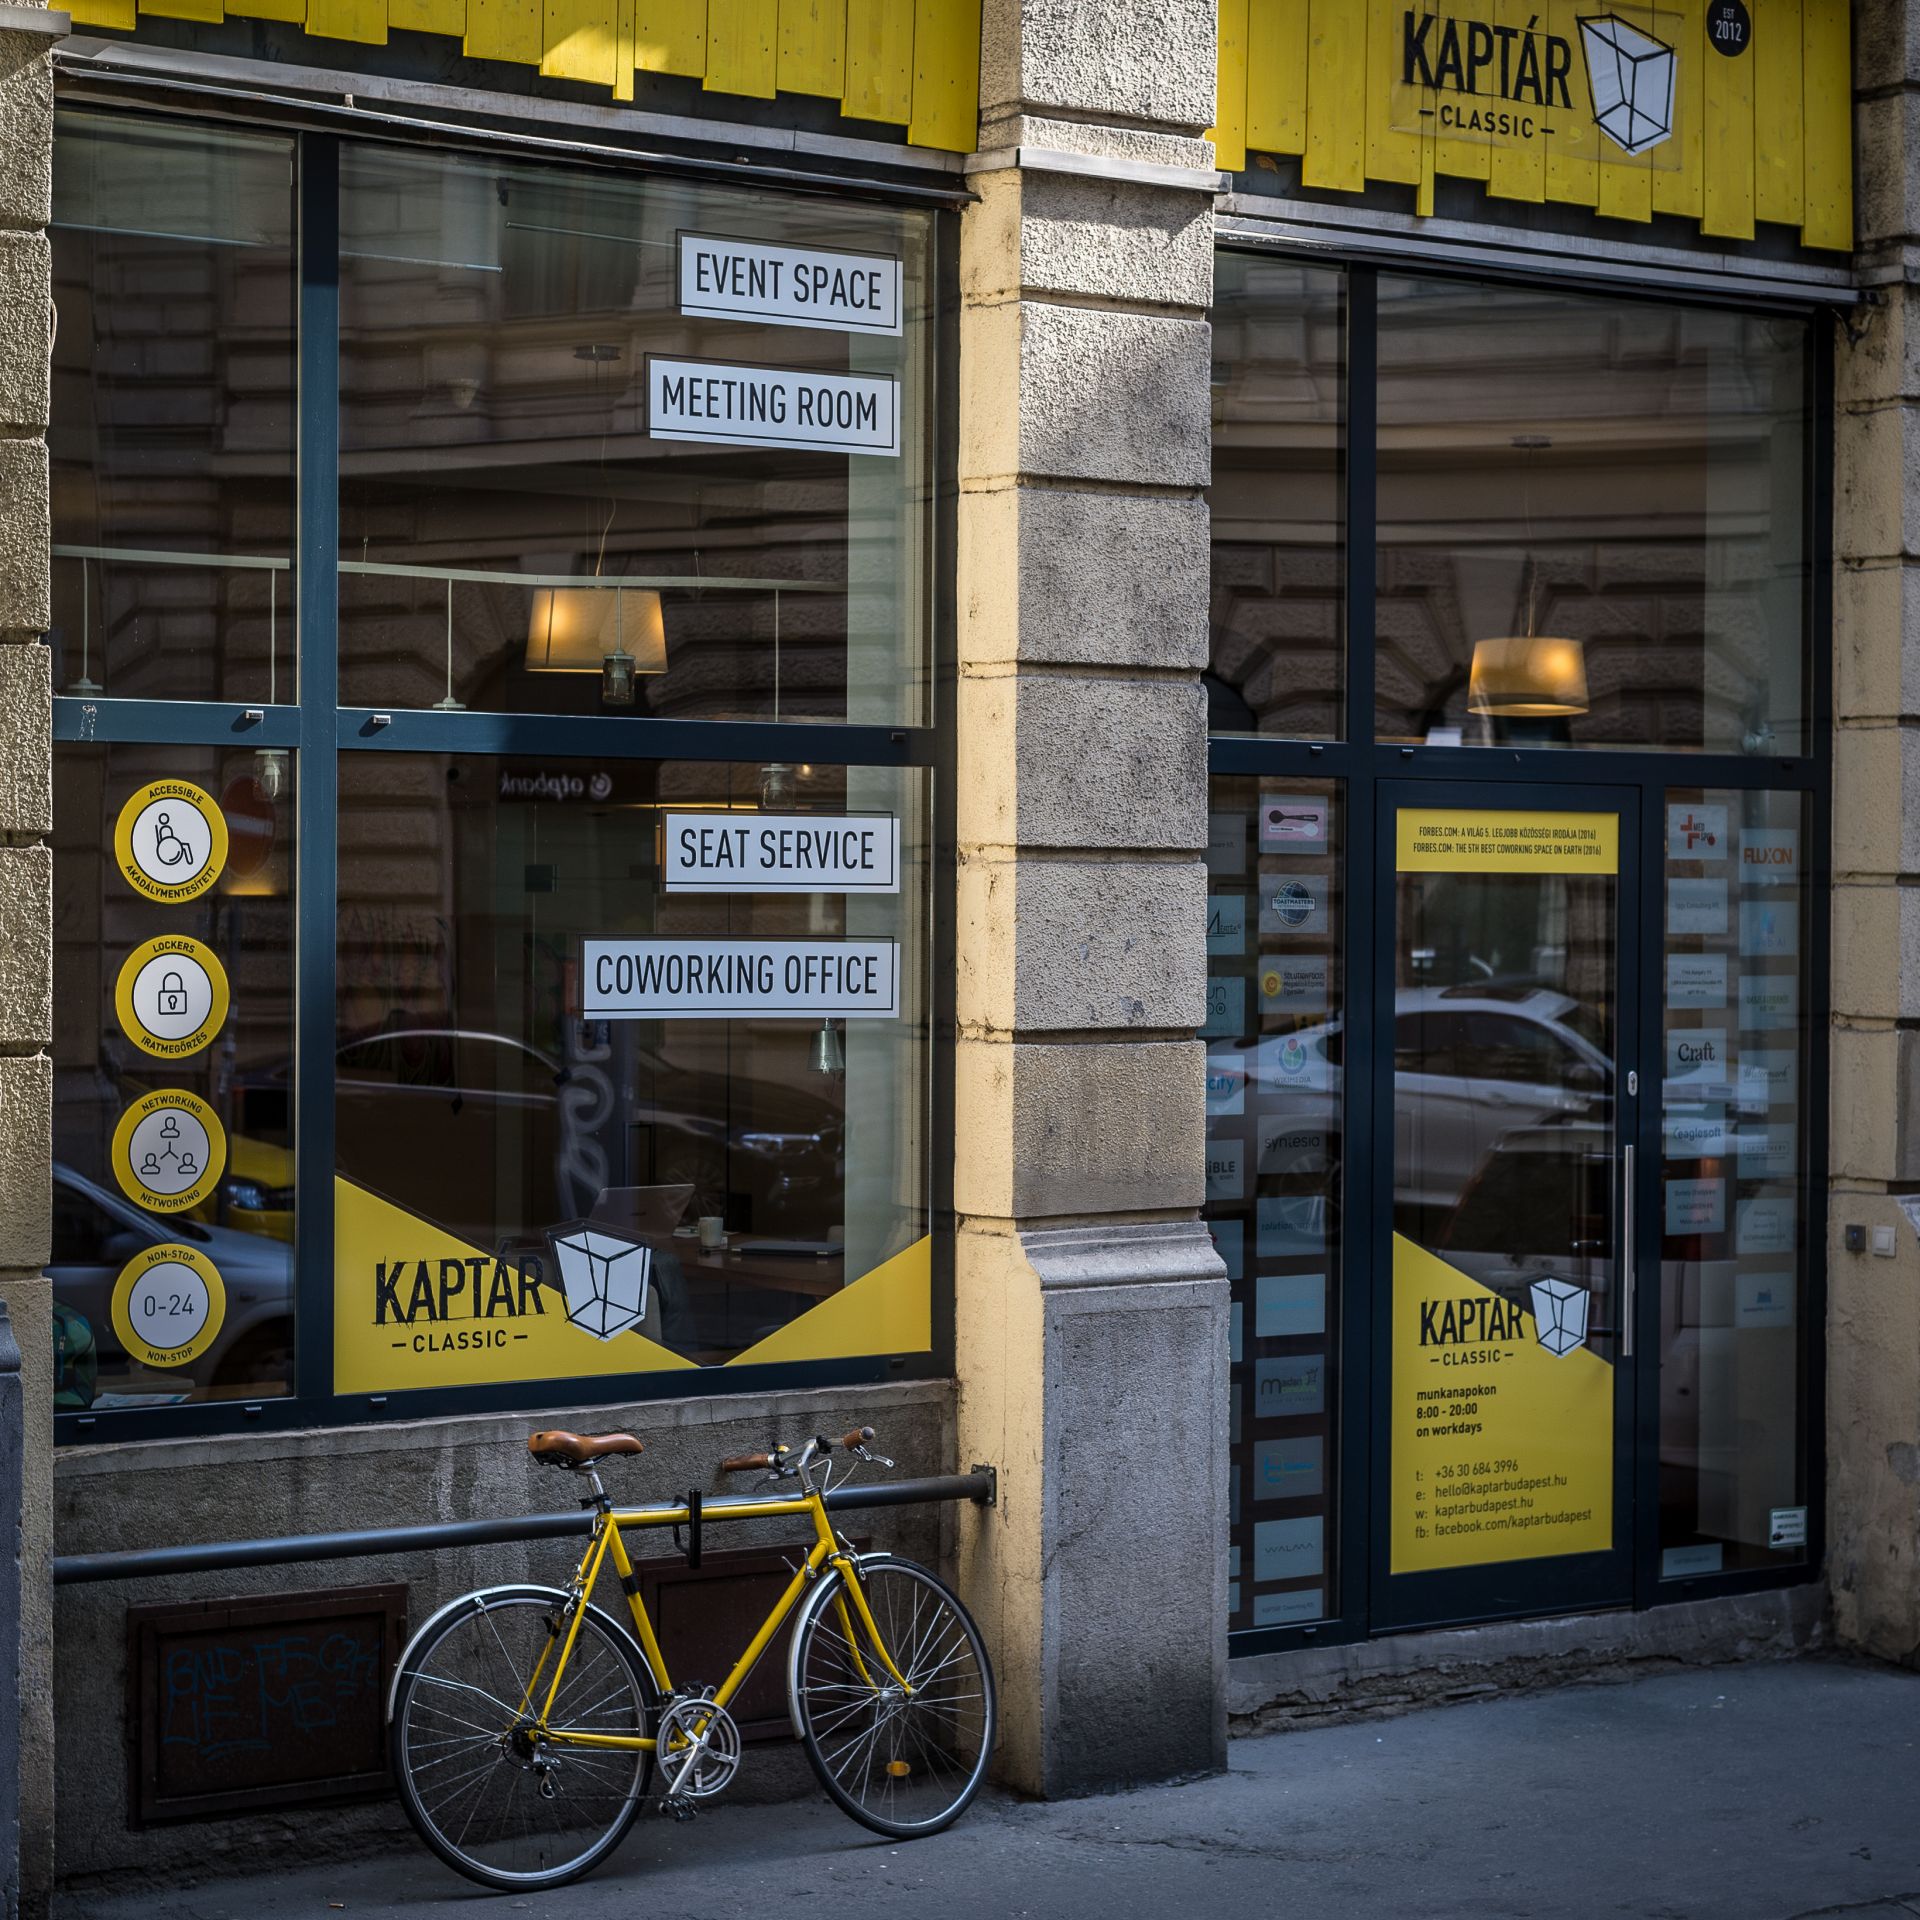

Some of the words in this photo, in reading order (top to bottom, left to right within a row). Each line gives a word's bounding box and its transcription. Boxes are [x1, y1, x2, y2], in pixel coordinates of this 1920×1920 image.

[1722, 8, 1735, 18] EST
[1716, 20, 1742, 42] 2012
[1404, 11, 1572, 109] KAPTÁR
[1440, 105, 1534, 139] CLASSIC
[696, 252, 783, 300] EVENT
[793, 263, 882, 311] SPACE
[662, 375, 786, 424] MEETING
[797, 387, 877, 431] ROOM
[149, 785, 204, 805] ACCESSIBLE
[1419, 826, 1460, 837] FORBES.COM:
[1461, 827, 1466, 837] A
[1466, 826, 1484, 838] VILÁG
[1492, 828, 1518, 838] LEGJOBB
[1552, 828, 1577, 839] IRODÁJA
[679, 828, 750, 868] SEAT
[760, 829, 874, 869] SERVICE
[1413, 843, 1454, 853] FORBES.COM:
[1456, 843, 1467, 853] THE
[1468, 844, 1479, 853] 5TH
[1481, 844, 1495, 854] BEST
[1496, 844, 1532, 854] COWORKING
[1534, 844, 1552, 854] SPACE
[1554, 845, 1562, 855] ON
[1564, 845, 1582, 855] EARTH
[1744, 848, 1793, 864] FLUXON
[125, 864, 216, 899] AKADÁLYMENTESÍTETT
[152, 940, 196, 953] LOCKERS
[596, 954, 774, 995] COWORKING
[784, 954, 878, 995] OFFICE
[141, 1032, 208, 1054] IRATMEGŐRZÉS
[1678, 1041, 1715, 1062] Craft
[141, 1095, 203, 1114] NETWORKING
[140, 1190, 200, 1207] NETWORKING
[147, 1250, 195, 1263] NON-STOP
[144, 1293, 194, 1317] 0-24
[413, 1329, 507, 1353] CLASSIC
[146, 1347, 193, 1362] NON-STOP
[1443, 1349, 1501, 1366] CLASSIC
[1416, 1384, 1497, 1400] munkanapokon
[1416, 1406, 1439, 1419] 8:00
[1449, 1402, 1478, 1417] 20:00
[1416, 1427, 1429, 1438] on
[1432, 1422, 1483, 1436] workdays
[1415, 1470, 1424, 1481] t:
[1435, 1465, 1455, 1479] +36
[1456, 1463, 1470, 1477] 30
[1472, 1462, 1491, 1476] 684
[1493, 1459, 1519, 1473] 3996
[1415, 1491, 1426, 1501] e:
[1435, 1474, 1568, 1499] hello@kaptarbudapest.hu
[1415, 1510, 1428, 1520] w:
[1434, 1497, 1534, 1517] kaptarbudapest.hu
[1415, 1526, 1429, 1539] fb:
[1434, 1508, 1592, 1536] facebook.com/kaptarbudapest
